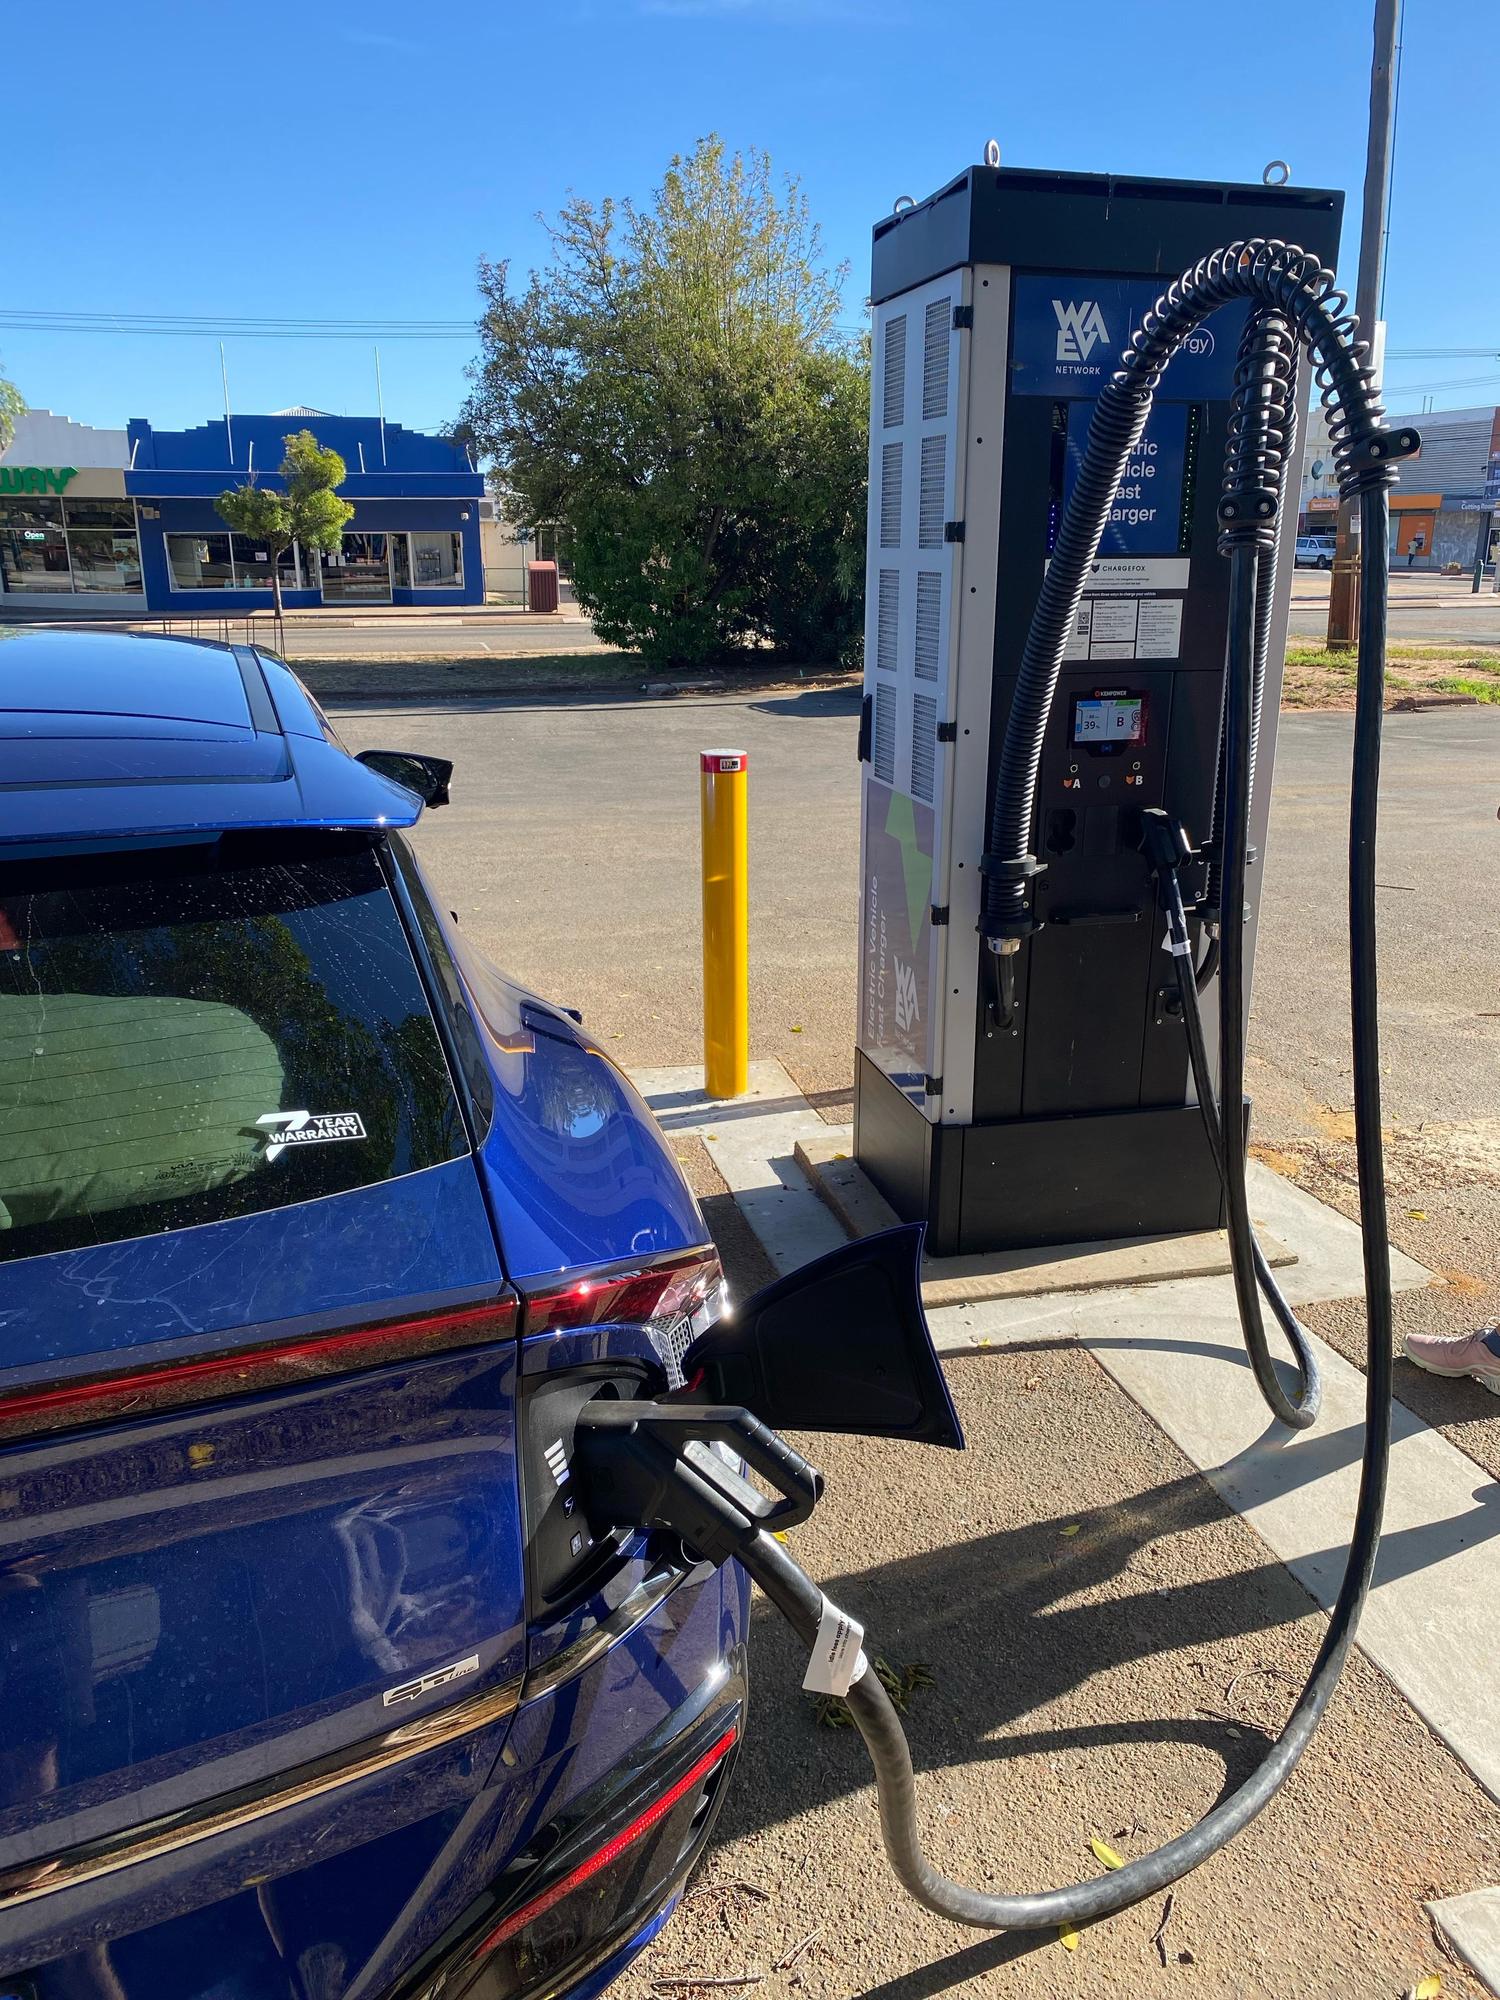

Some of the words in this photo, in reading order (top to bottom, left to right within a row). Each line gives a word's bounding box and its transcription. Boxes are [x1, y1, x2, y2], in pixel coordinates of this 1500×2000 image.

[1055, 365, 1101, 375] NETWORK
[1115, 484, 1141, 499] ast
[24, 531, 45, 539] Open
[1084, 721, 1096, 730] 39
[1117, 717, 1125, 727] B
[1072, 778, 1081, 789] A
[1135, 775, 1144, 786] B
[869, 875, 878, 954] Vehicle
[877, 910, 888, 999] Charger
[867, 960, 876, 1040] Electric
[877, 1004, 885, 1048] Fast
[313, 1116, 357, 1128] YEAR
[268, 1125, 358, 1144] WARRANTY
